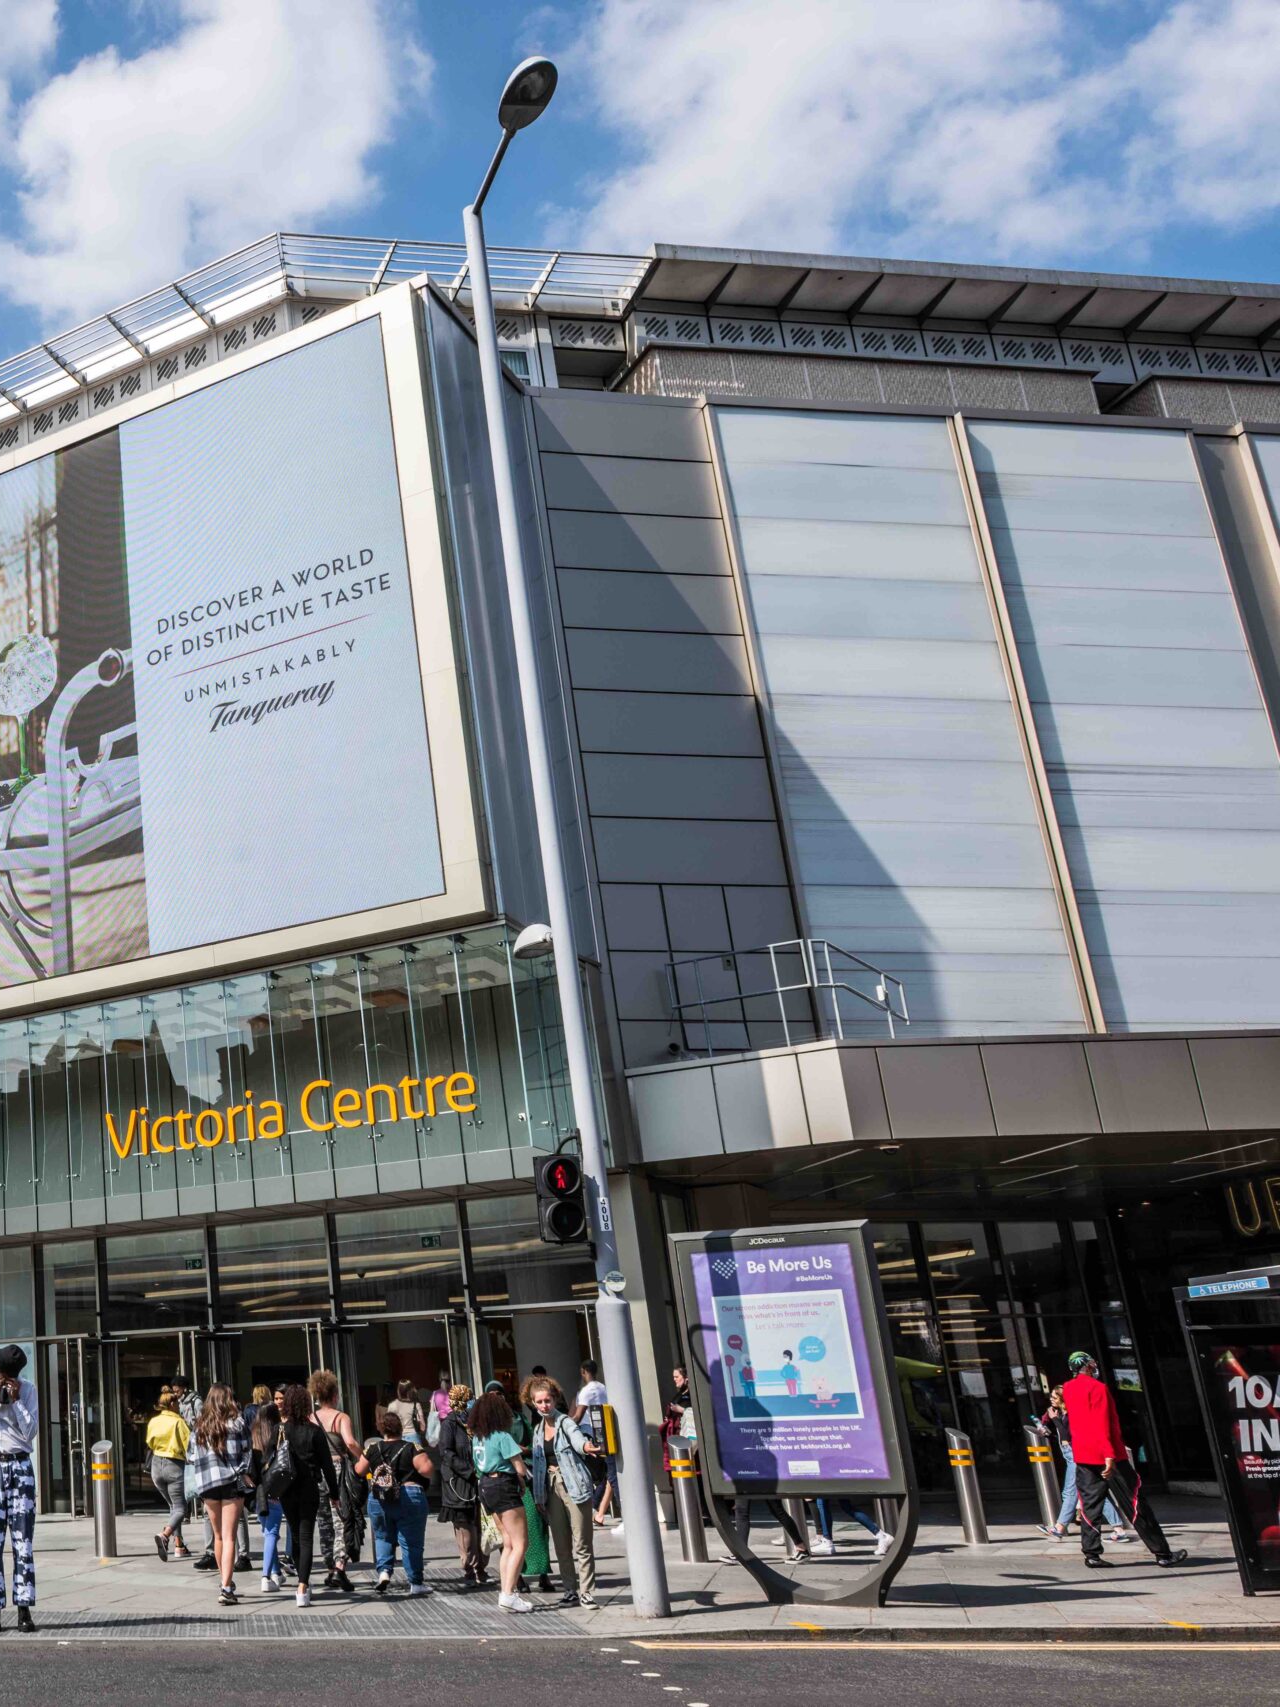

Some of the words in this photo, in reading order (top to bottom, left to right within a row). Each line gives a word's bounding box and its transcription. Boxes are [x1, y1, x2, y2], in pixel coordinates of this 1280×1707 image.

[157, 585, 263, 635] DISCOVER
[271, 579, 286, 597] A
[292, 548, 374, 587] WORLD
[146, 644, 173, 666] OF
[181, 598, 314, 656] DISTINCTIVE
[321, 572, 392, 609] TASTE
[184, 638, 356, 703] UNMISTAKABLY
[208, 679, 335, 733] Tanqueray
[104, 1088, 285, 1160] Victoria
[300, 1070, 477, 1132] Centre
[748, 1237, 786, 1246] JCDecaux
[746, 1261, 766, 1274] Be
[768, 1258, 809, 1273] More
[812, 1256, 833, 1269] Us
[795, 1274, 833, 1282] #BeMoreUs
[1207, 1280, 1258, 1293] TELEPHONE
[757, 1302, 788, 1310] addiction
[1228, 1374, 1280, 1409] 10
